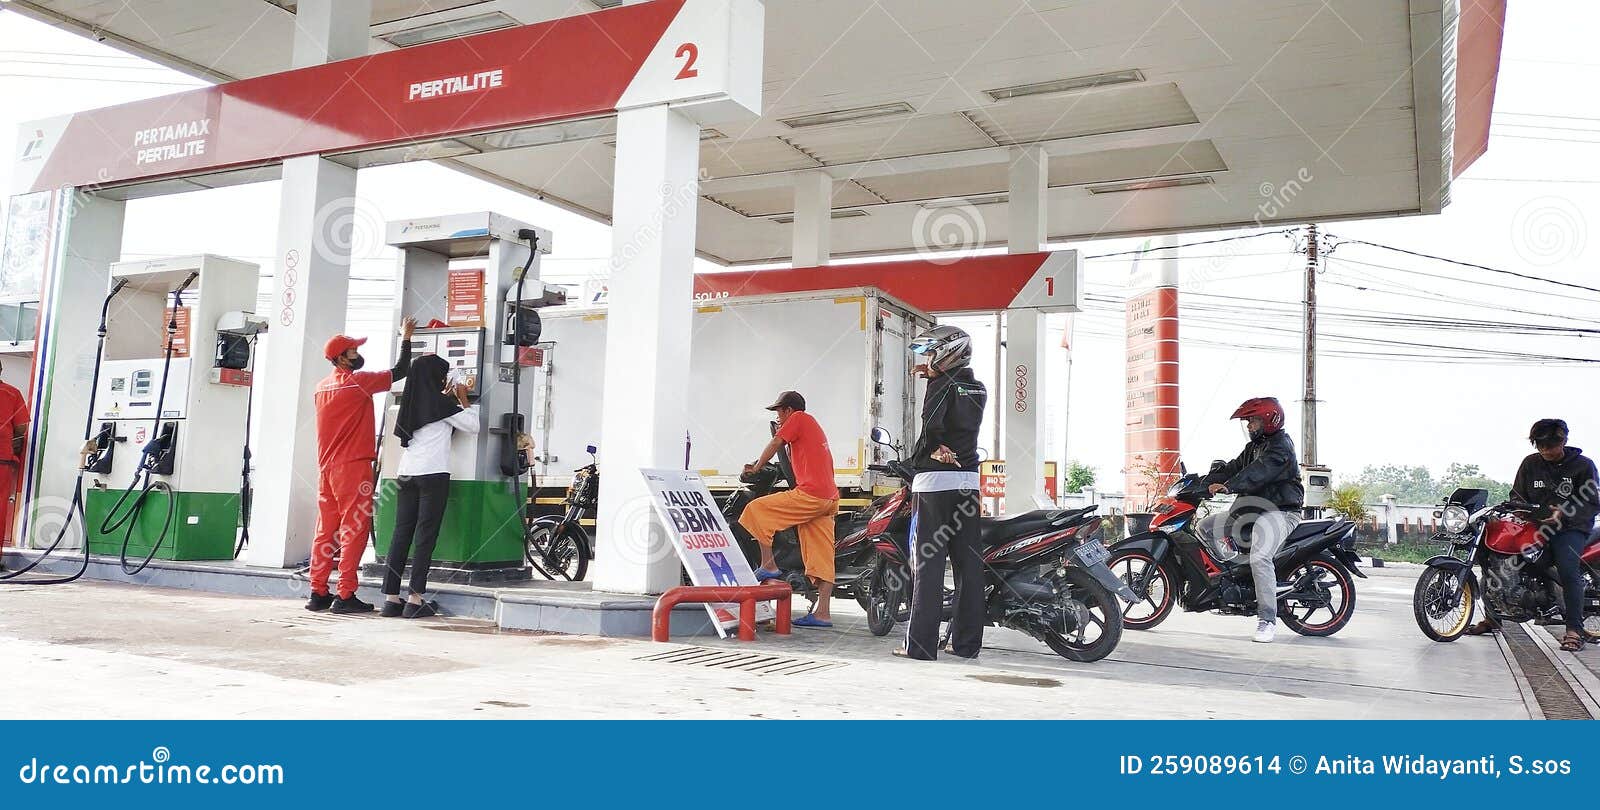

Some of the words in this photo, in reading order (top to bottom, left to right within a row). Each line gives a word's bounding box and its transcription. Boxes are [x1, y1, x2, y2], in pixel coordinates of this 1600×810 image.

[674, 43, 698, 80] 2
[409, 70, 502, 100] PERTALITE
[134, 119, 210, 146] PERTAMAX
[137, 140, 205, 165] PERTALITE
[1045, 277, 1054, 296] 1
[661, 491, 708, 507] JALUR
[667, 508, 722, 533] BBM
[683, 534, 730, 550] SUBSIDI
